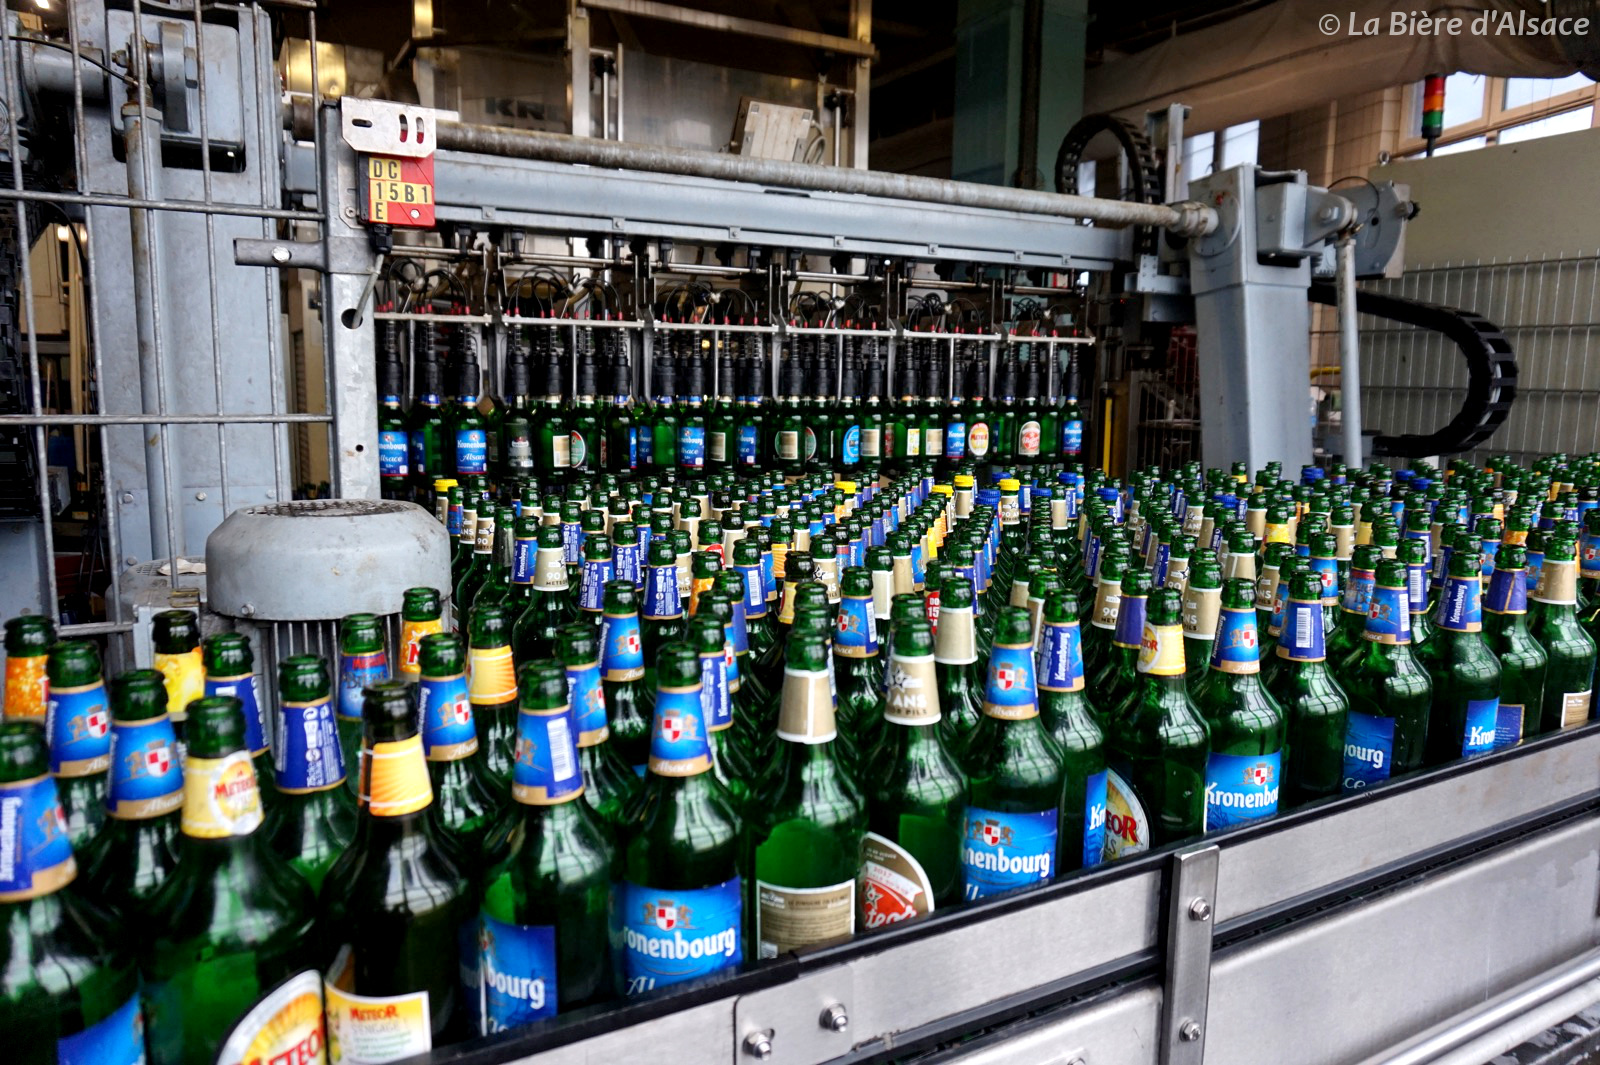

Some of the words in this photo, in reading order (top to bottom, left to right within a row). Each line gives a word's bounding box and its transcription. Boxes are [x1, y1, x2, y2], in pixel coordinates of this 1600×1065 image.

[373, 160, 398, 179] DC
[375, 201, 384, 220] E
[476, 538, 488, 546] 90
[517, 543, 529, 578] Kronenbourg
[546, 572, 561, 580] 90
[1102, 607, 1118, 618] 90
[1449, 584, 1468, 625] Kronenbourg
[1054, 631, 1071, 682] Kronenbourg
[892, 694, 928, 709] ANS
[1204, 781, 1279, 809] Kronenbo
[624, 923, 737, 958] ronenbourg
[350, 1004, 399, 1022] METEOR
